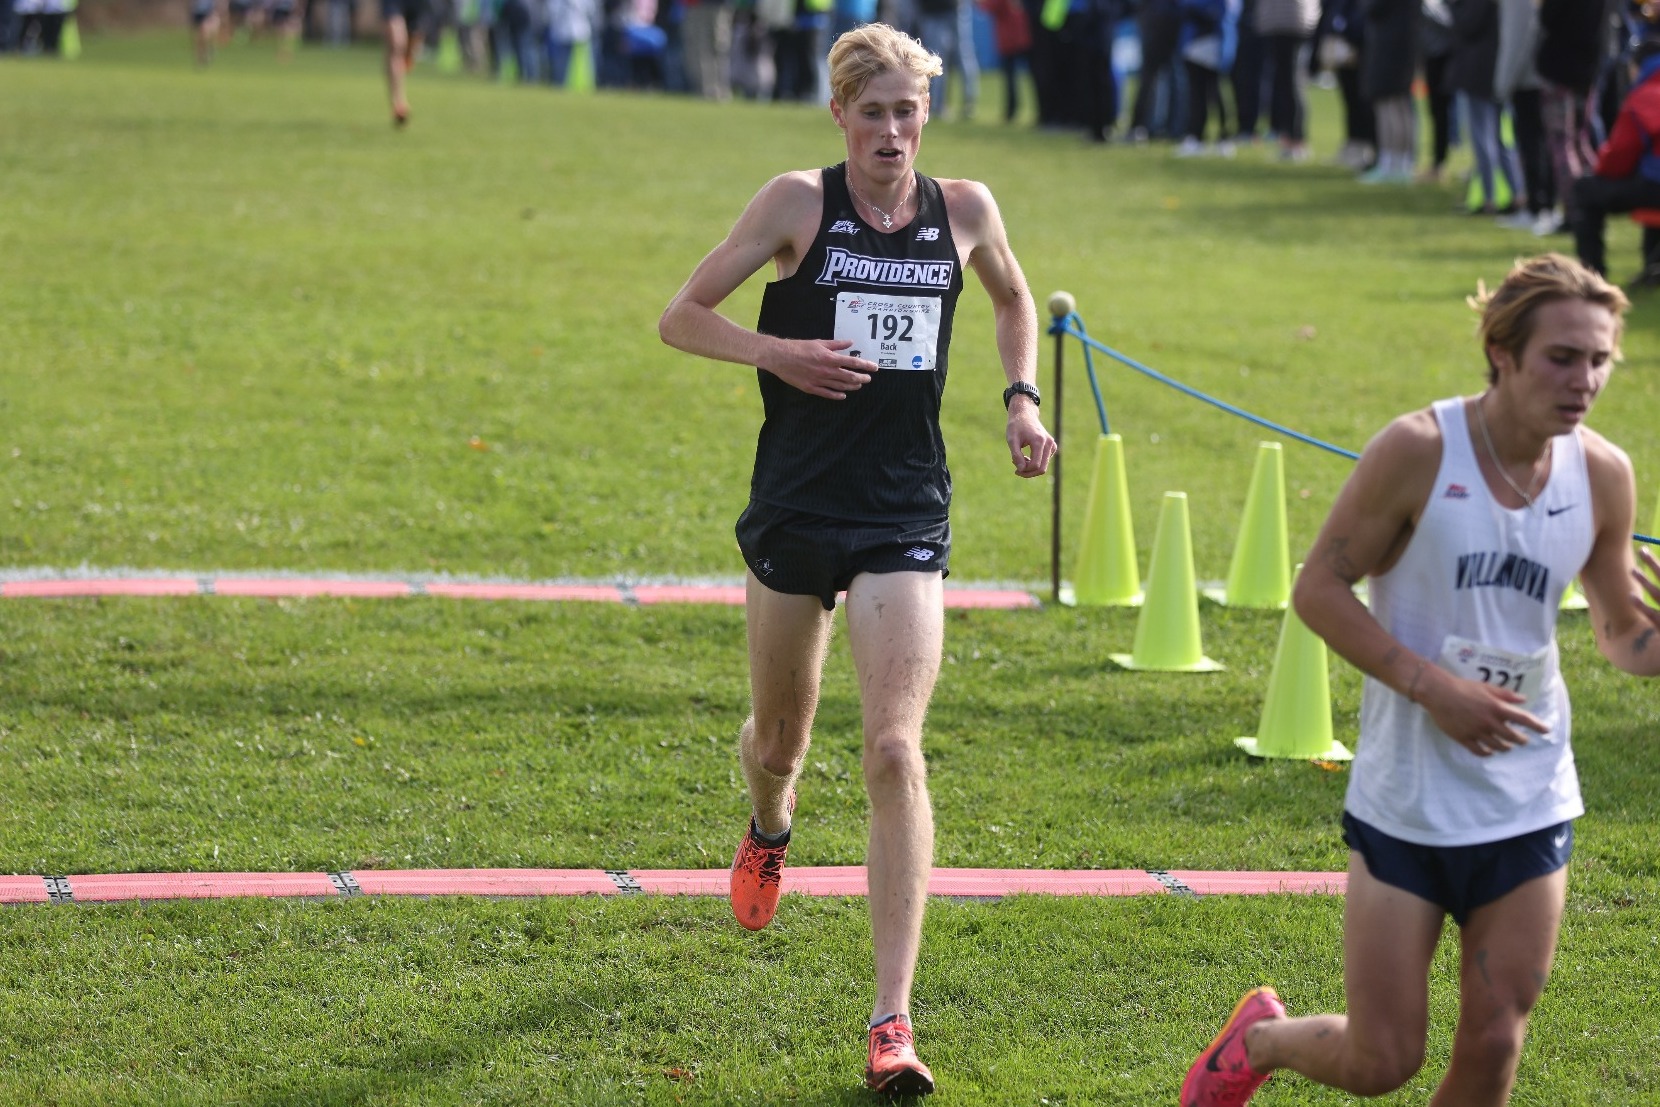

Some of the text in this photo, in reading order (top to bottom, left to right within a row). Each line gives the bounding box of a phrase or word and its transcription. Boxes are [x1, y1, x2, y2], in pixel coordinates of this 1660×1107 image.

[821, 250, 952, 286] PROVIDENCE
[867, 313, 914, 342] 192
[880, 342, 898, 351] Back
[1454, 551, 1549, 604] VILLANOVA
